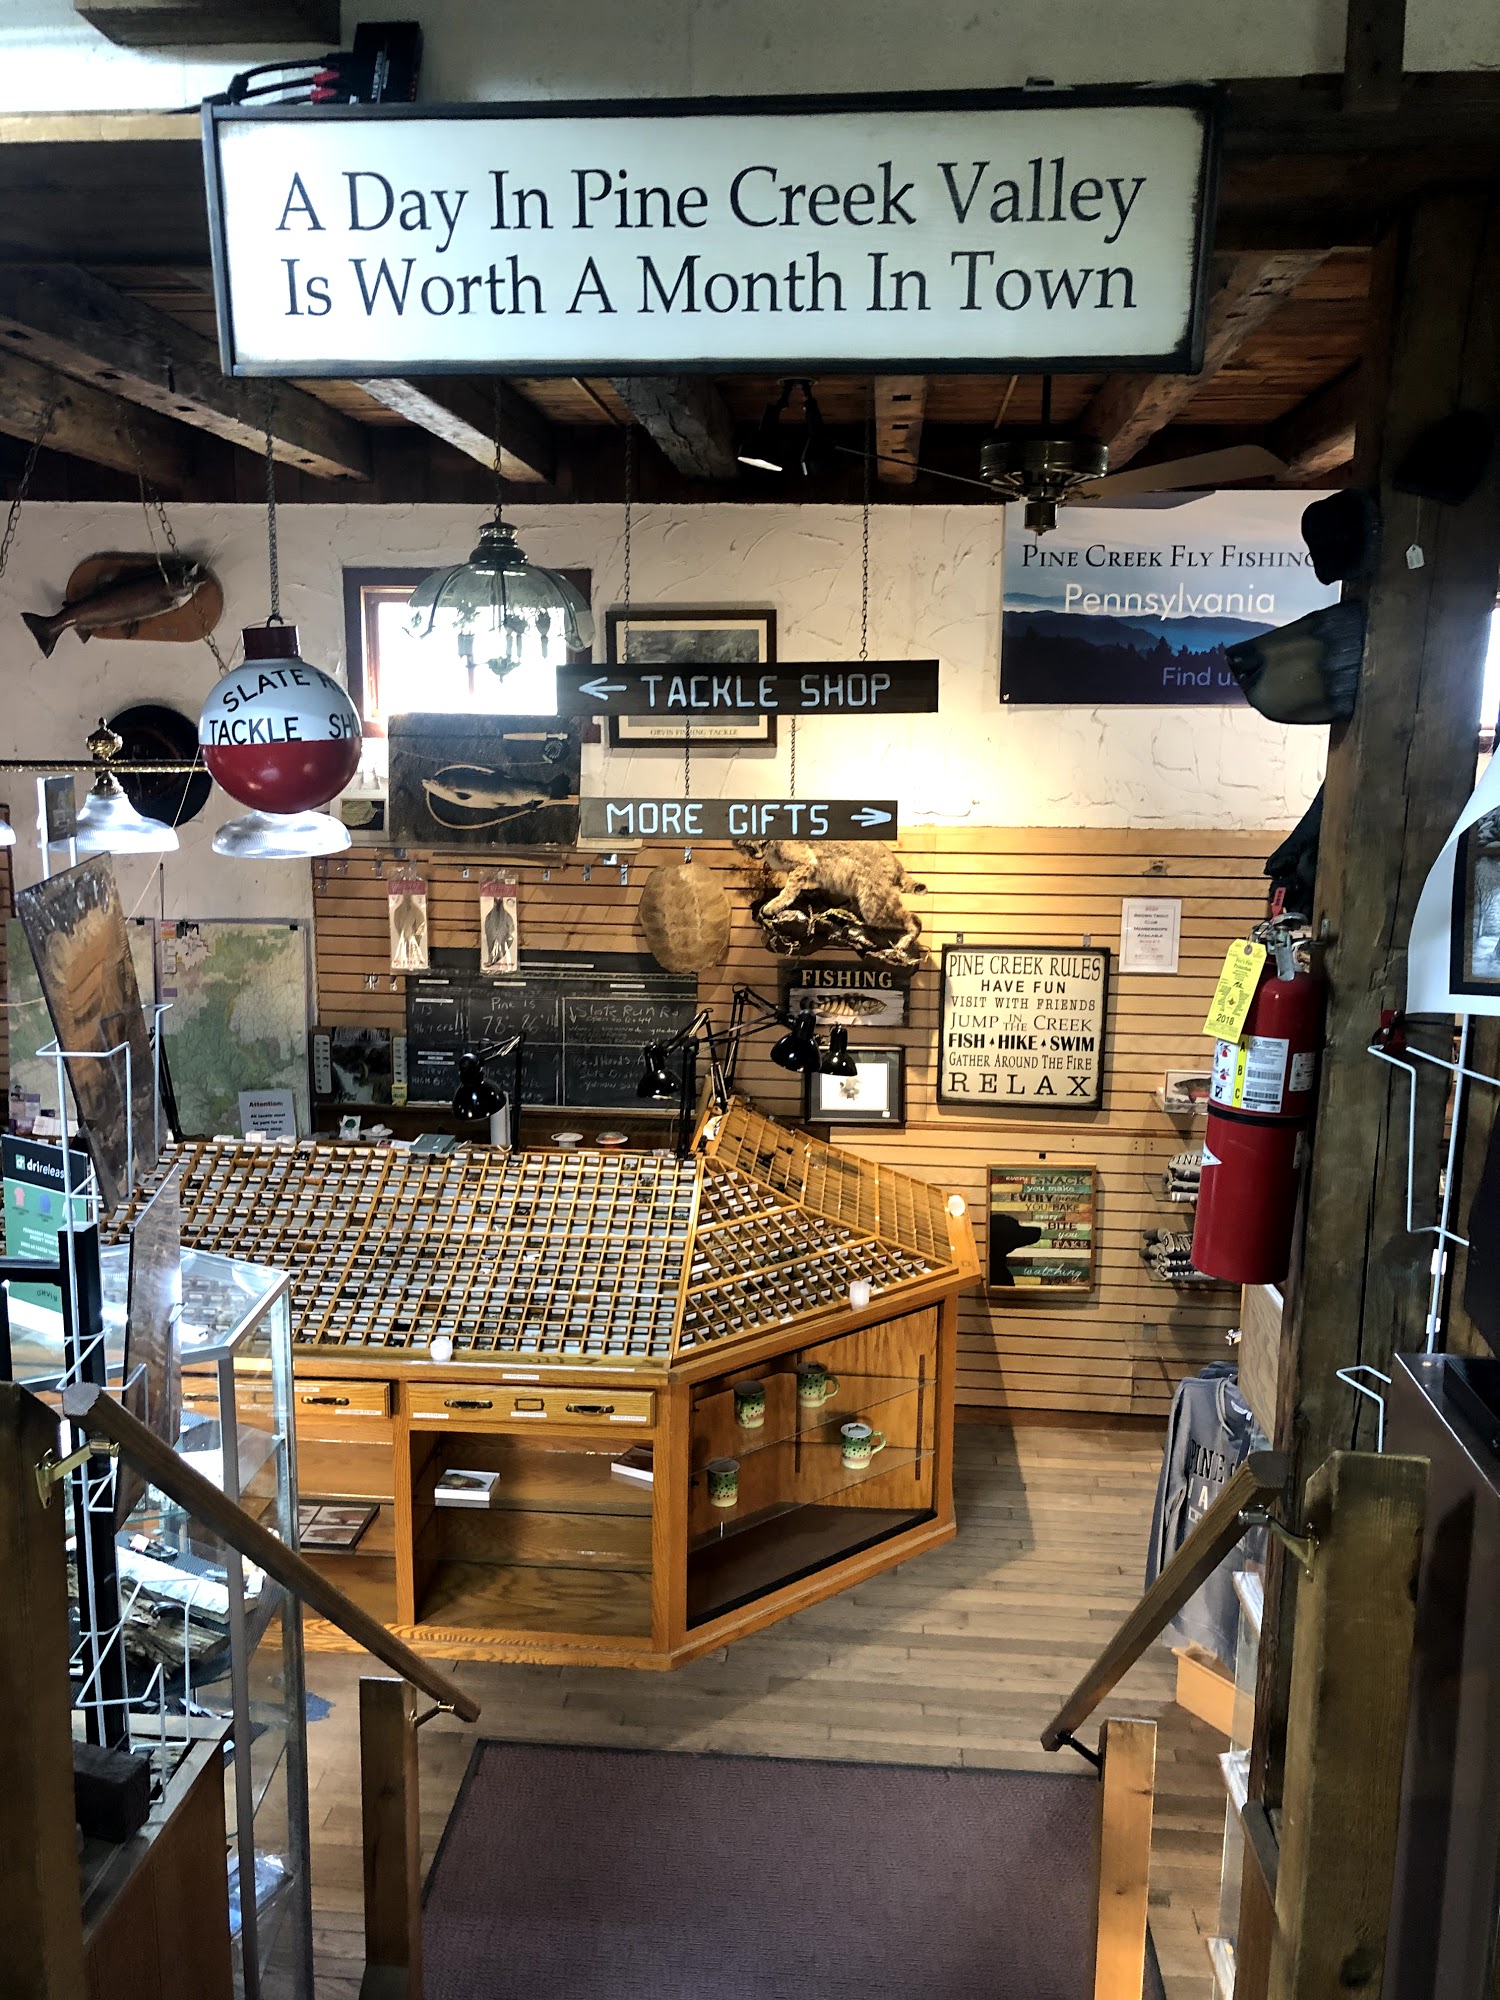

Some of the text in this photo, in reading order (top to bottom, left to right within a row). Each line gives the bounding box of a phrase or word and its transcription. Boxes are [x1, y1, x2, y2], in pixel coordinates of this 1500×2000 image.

[276, 157, 1147, 253] A Day In Pine Creek Valley
[281, 250, 1137, 316] Is Worth A Month In Town
[1021, 544, 1078, 567] PINE
[1085, 544, 1162, 567] CREEK
[1170, 544, 1214, 567] FLY
[1064, 582, 1275, 621] Pennsylvania
[1162, 666, 1211, 687] Find
[222, 668, 310, 713] SLATE
[640, 673, 891, 708] TACKLE SHOP
[209, 716, 302, 746] TACKLE
[606, 802, 829, 835] MORE GIFTS
[949, 954, 1101, 981] PINE CREEK RULES
[801, 969, 893, 988] FISHING
[981, 979, 1066, 994] HAVE FUN
[951, 996, 1095, 1011] VISIT WITH FRIENDS
[950, 1012, 1093, 1032] JUMP IN THE CREEK
[1216, 1013, 1235, 1026] 2018
[948, 1033, 1094, 1052] FISH HIKE SWIM
[1240, 1041, 1246, 1052] A
[949, 1052, 1092, 1070] GATHER AROUND THE FIRE
[1237, 1065, 1243, 1076] B
[948, 1072, 1091, 1096] RELAX
[1234, 1088, 1240, 1099] C
[1006, 1175, 1085, 1185] every SNACK
[1027, 1184, 1074, 1193] you make
[1010, 1193, 1054, 1203] EVERY
[1025, 1203, 1080, 1212] YOU BAKE
[1047, 1222, 1078, 1230] BITE
[1058, 1231, 1079, 1239] you
[1053, 1240, 1089, 1249] TAKE
[1024, 1264, 1082, 1280] watching
[1189, 1439, 1225, 1483] PINE
